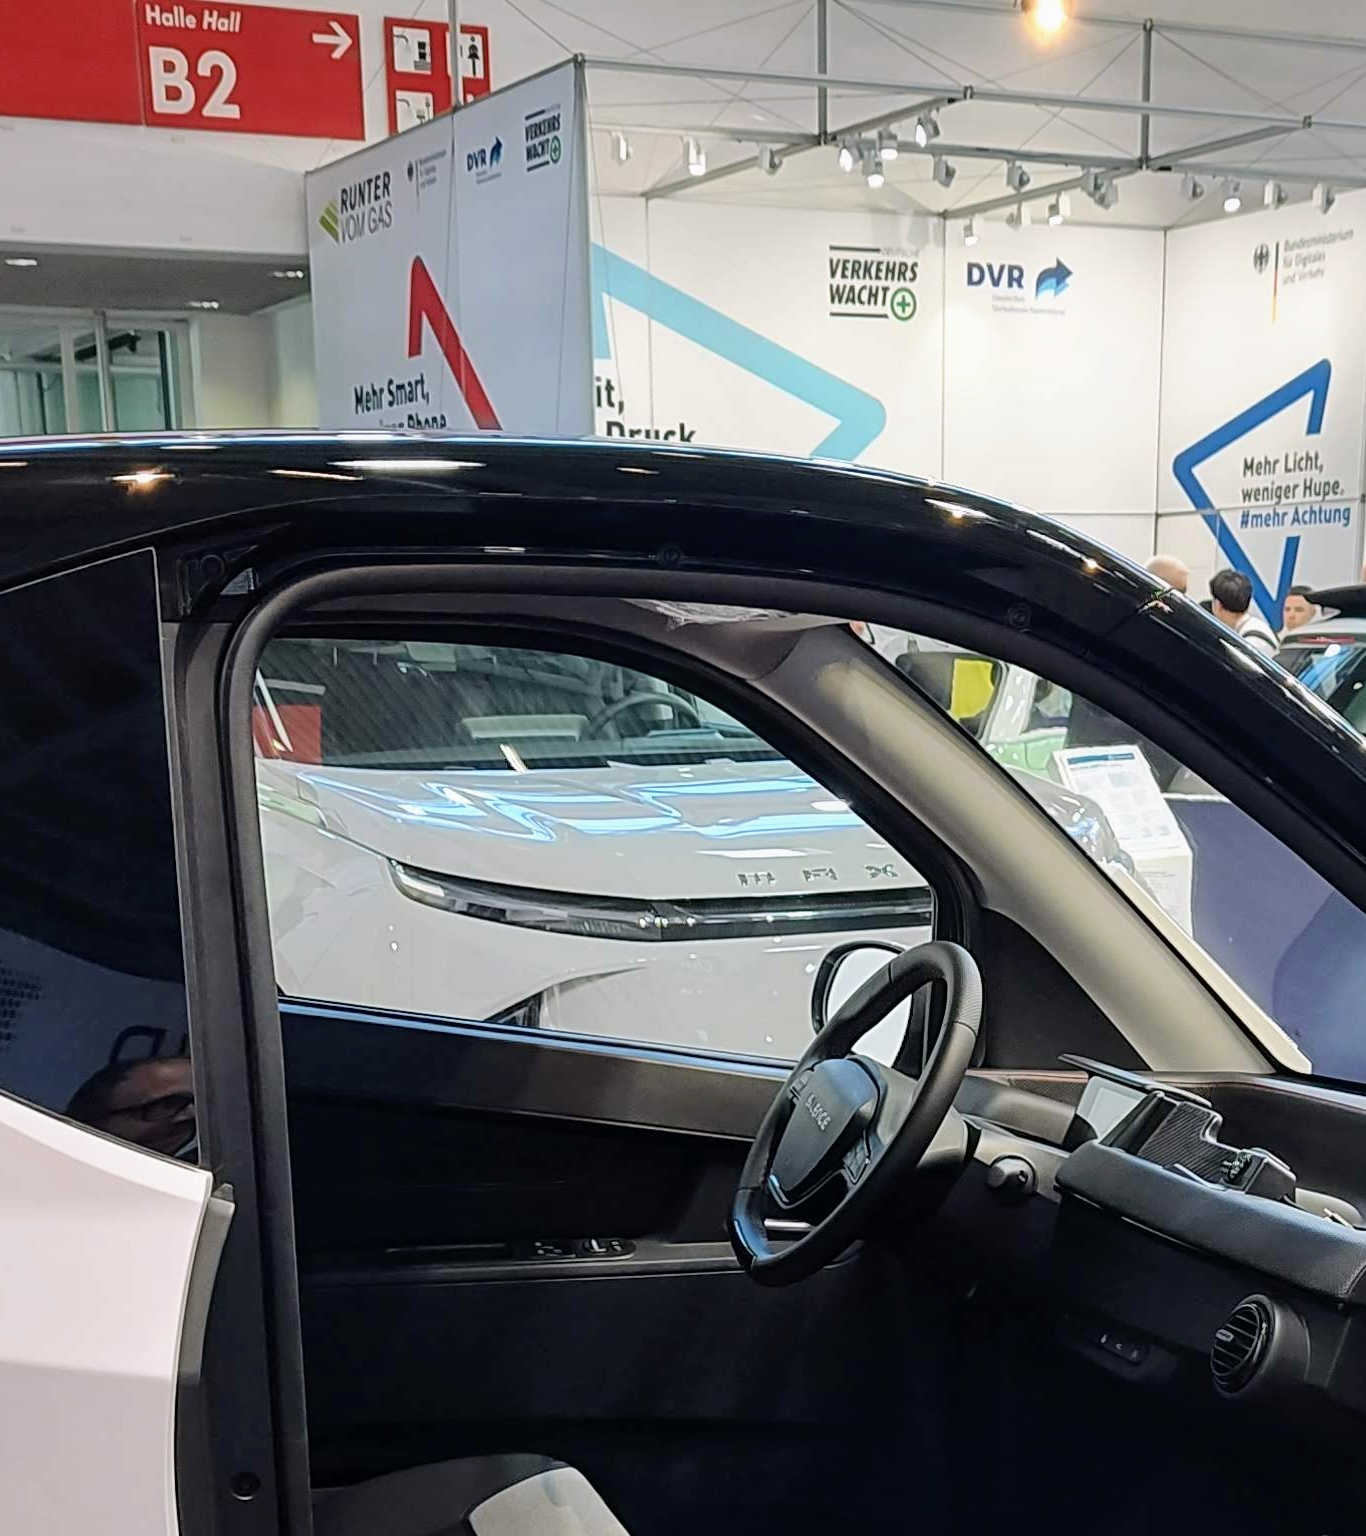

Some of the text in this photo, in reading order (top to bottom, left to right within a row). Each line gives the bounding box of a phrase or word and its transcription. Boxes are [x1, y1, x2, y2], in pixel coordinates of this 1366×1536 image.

[144, 4, 241, 33] Halle Hall
[148, 46, 241, 120] B2
[467, 148, 487, 172] DVR
[340, 171, 391, 214] RUNTER
[341, 201, 393, 243] VOM GAS
[829, 258, 919, 283] VERKEHRS
[966, 262, 1025, 289] DVR
[829, 284, 890, 307] WACHT
[353, 371, 430, 415] Mehr Smart,
[595, 375, 624, 416] it,
[1243, 450, 1324, 477] Mehr Licht,
[1241, 477, 1345, 505] weniger Hupe.
[1240, 505, 1351, 529] #mehr Achtung
